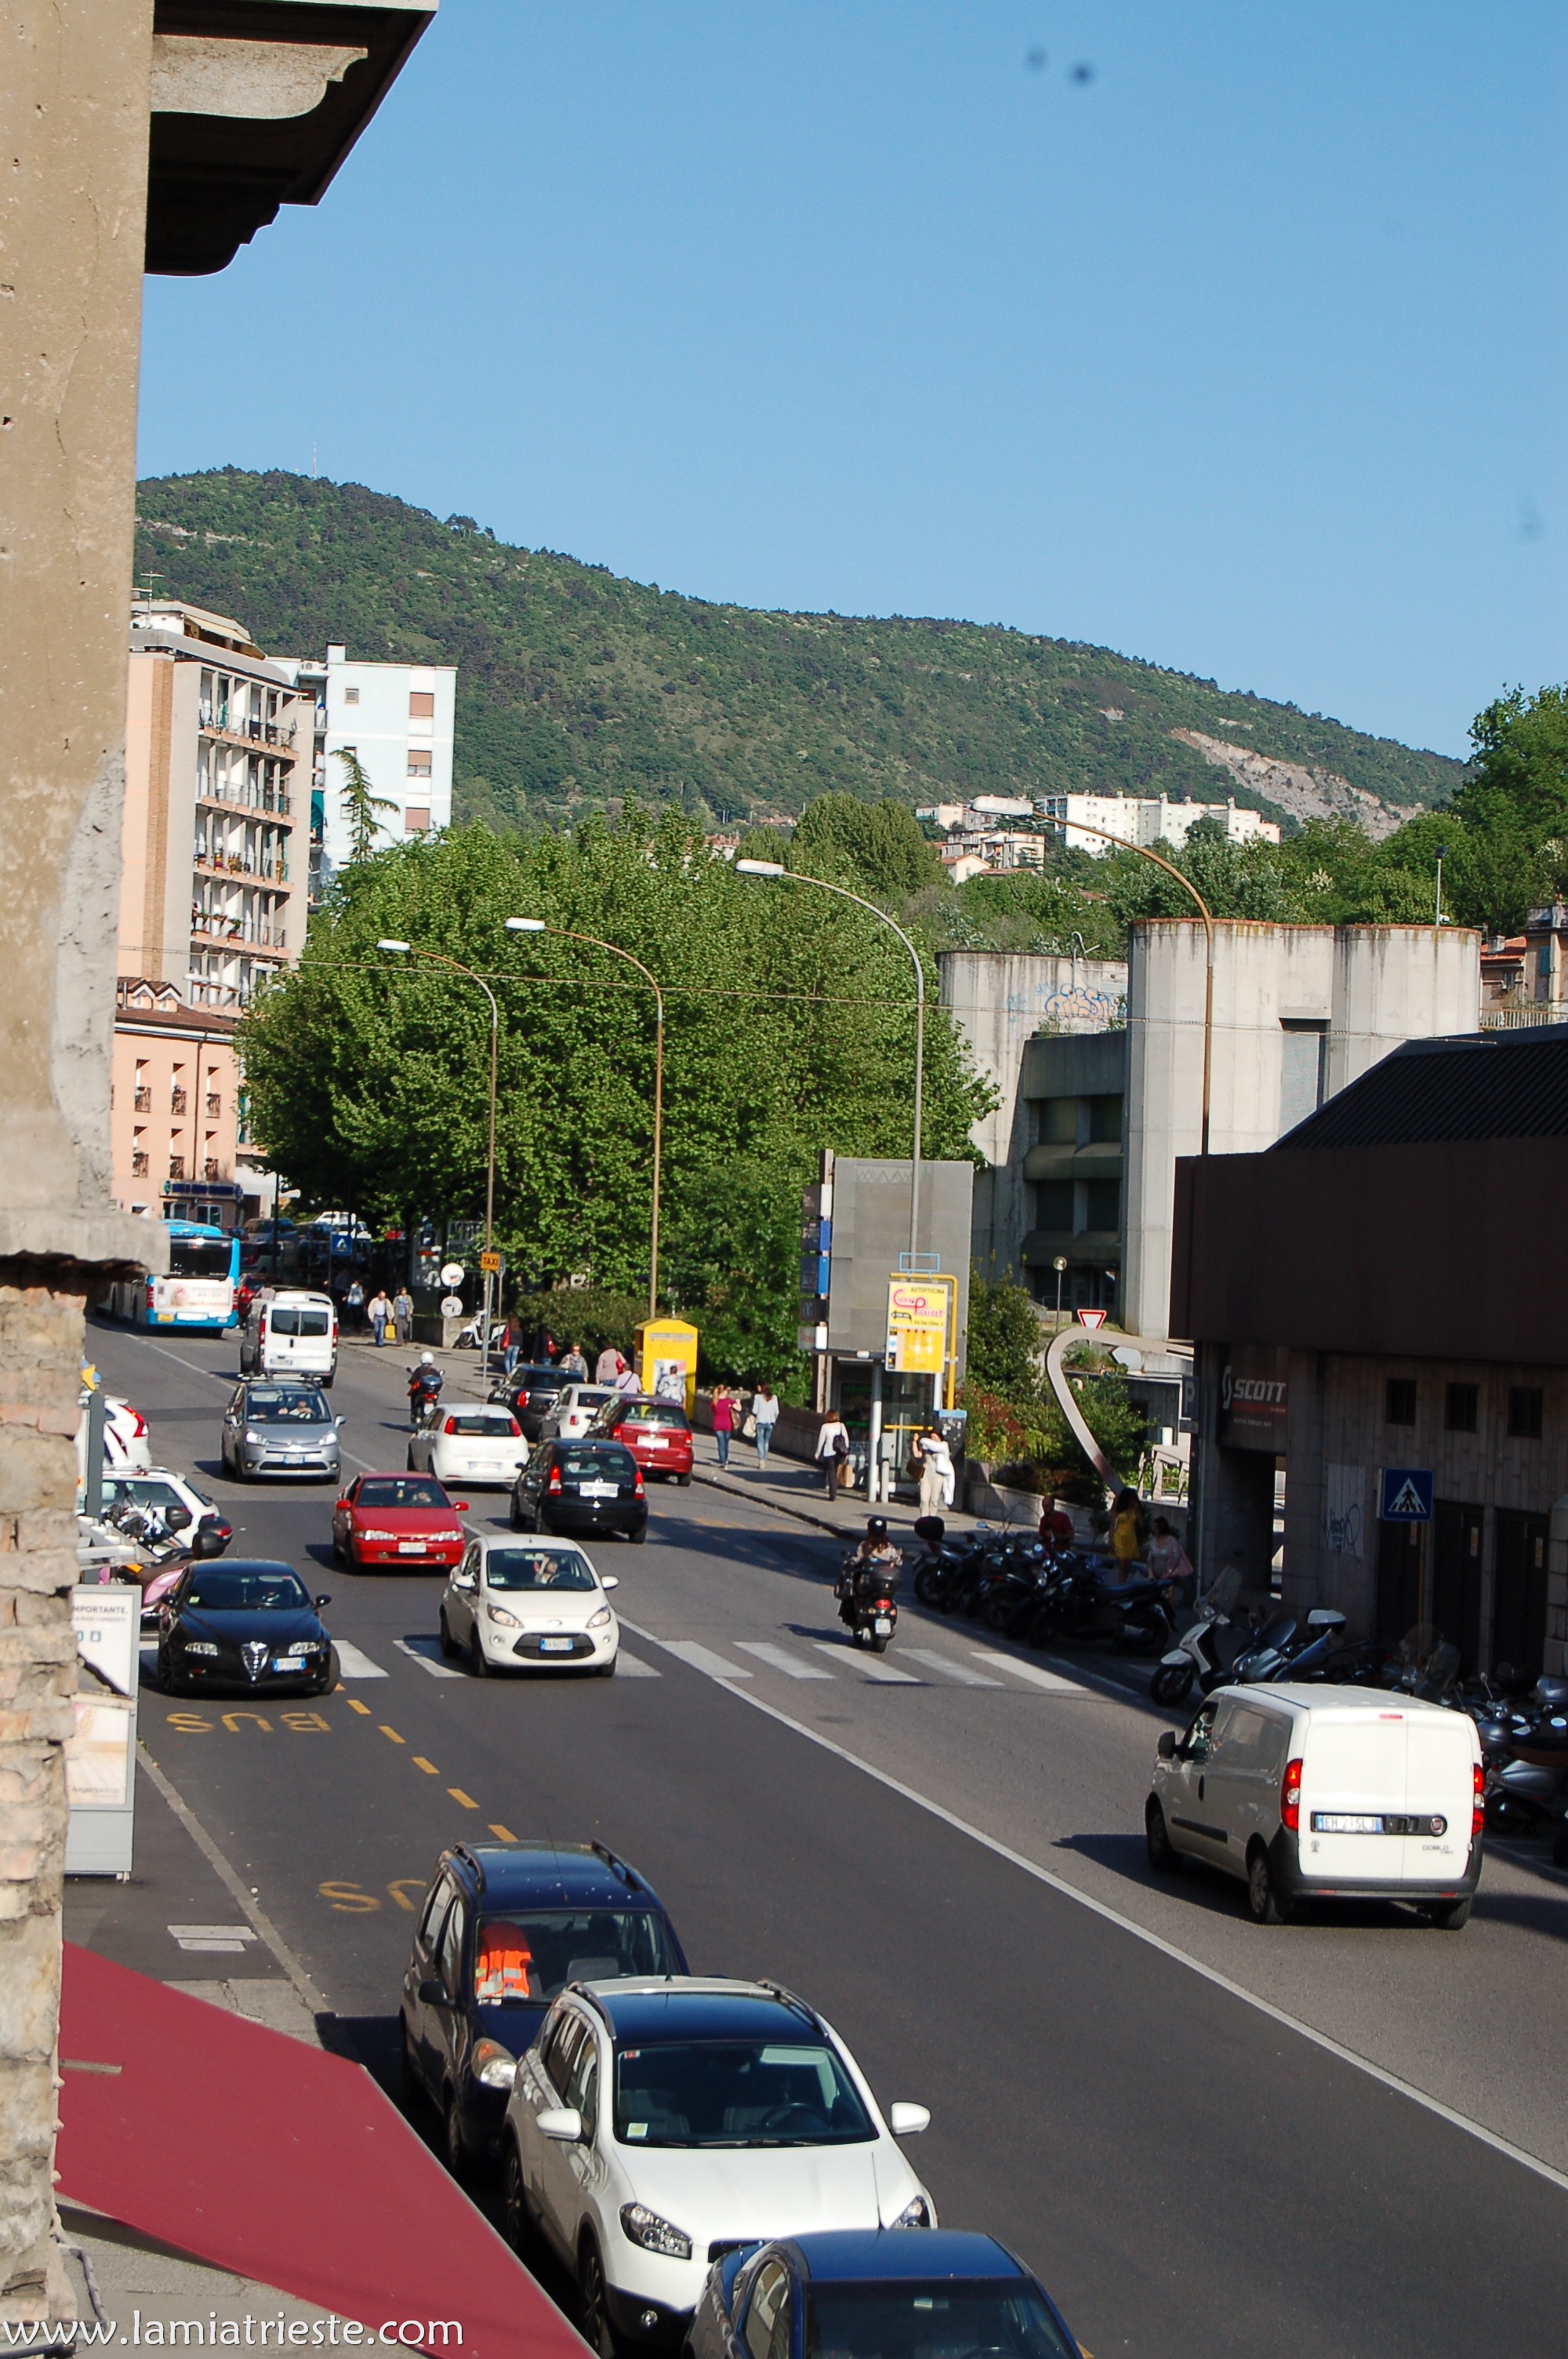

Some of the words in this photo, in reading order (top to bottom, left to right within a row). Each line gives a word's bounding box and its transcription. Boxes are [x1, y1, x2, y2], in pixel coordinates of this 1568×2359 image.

[483, 1257, 498, 1266] TAXI
[1184, 1381, 1195, 1414] P
[1232, 1379, 1286, 1402] SCOTT
[72, 1605, 128, 1614] MPORTANTE.
[166, 1713, 331, 1733] BUS
[318, 1880, 427, 1913] US
